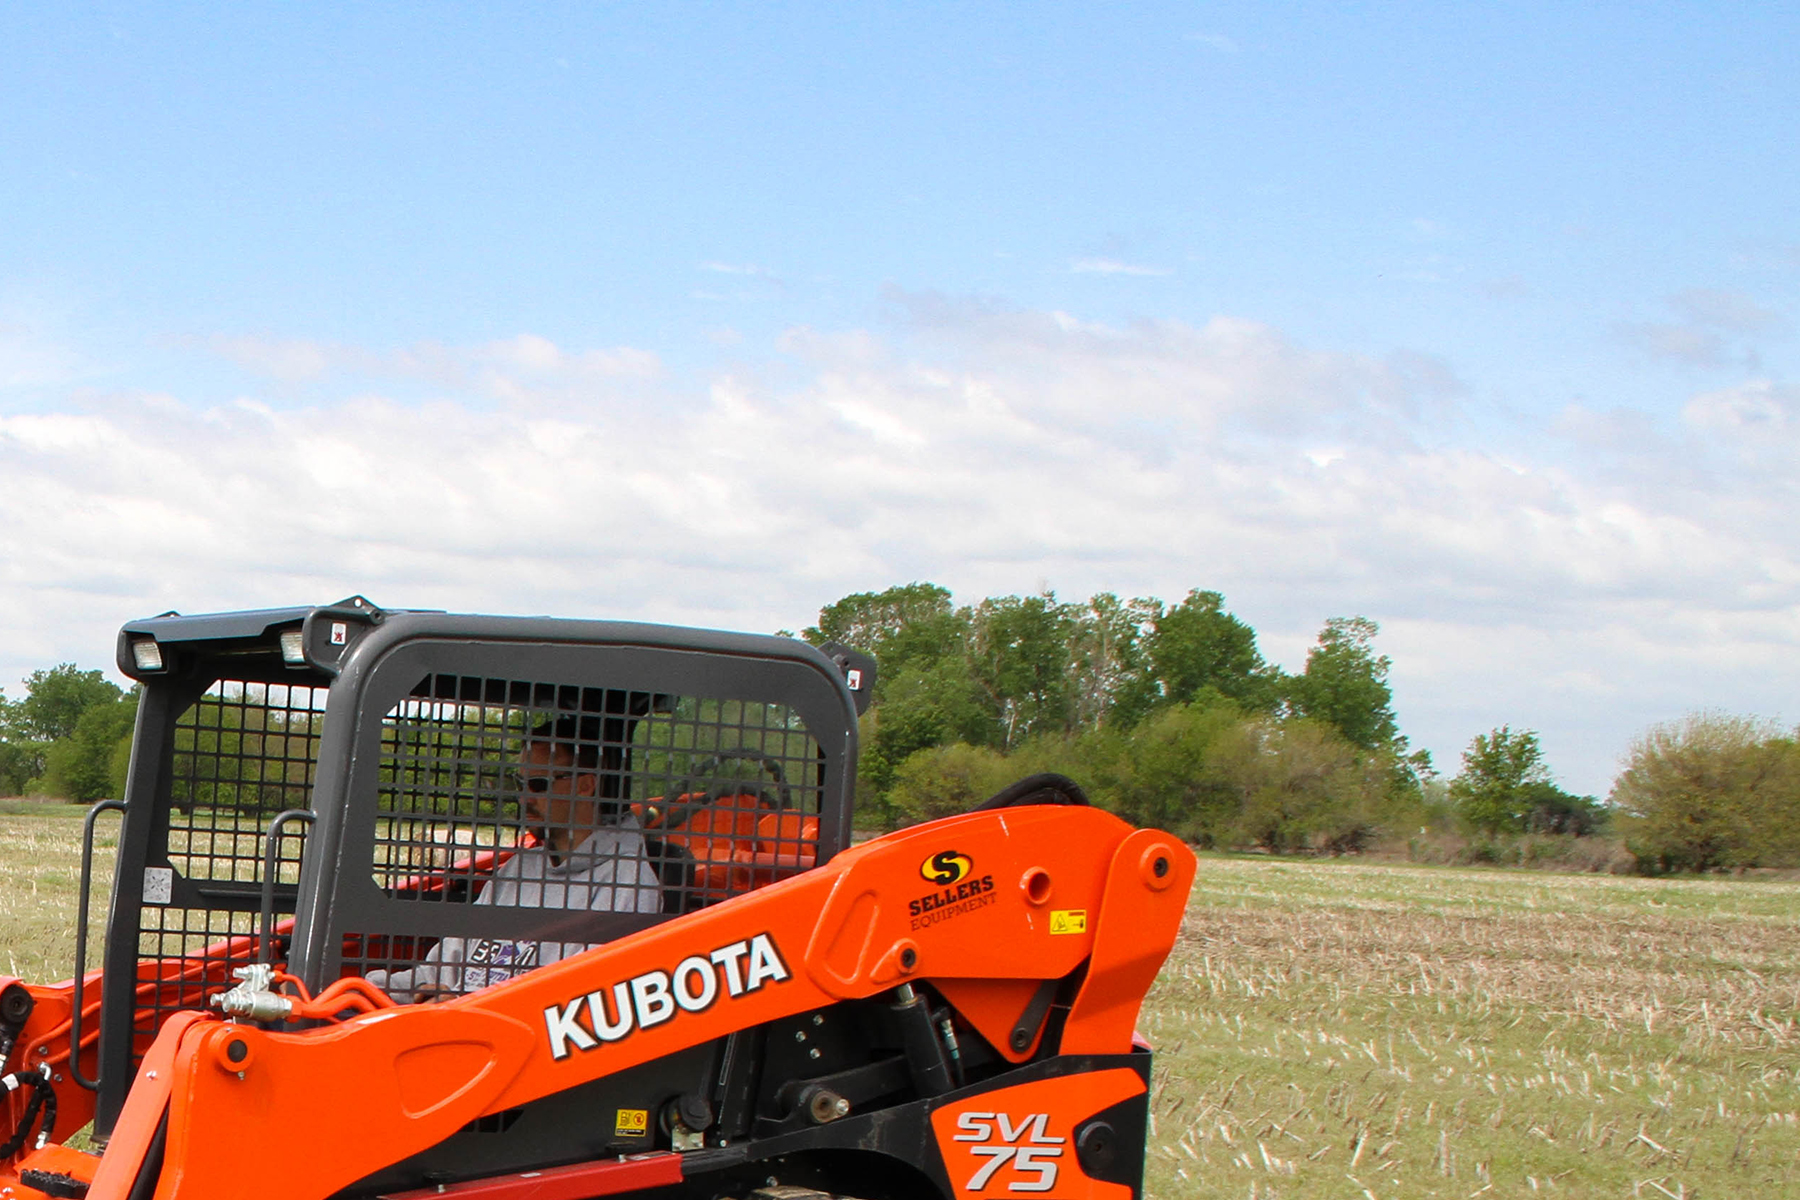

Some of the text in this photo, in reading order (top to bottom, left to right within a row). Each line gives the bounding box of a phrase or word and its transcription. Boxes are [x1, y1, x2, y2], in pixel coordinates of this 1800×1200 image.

[931, 849, 961, 886] S
[908, 874, 995, 917] SELLERS
[910, 891, 997, 932] EQUIPMENT
[543, 932, 791, 1061] KUBOTA
[952, 1111, 1066, 1144] SVL
[965, 1145, 1064, 1192] 75
